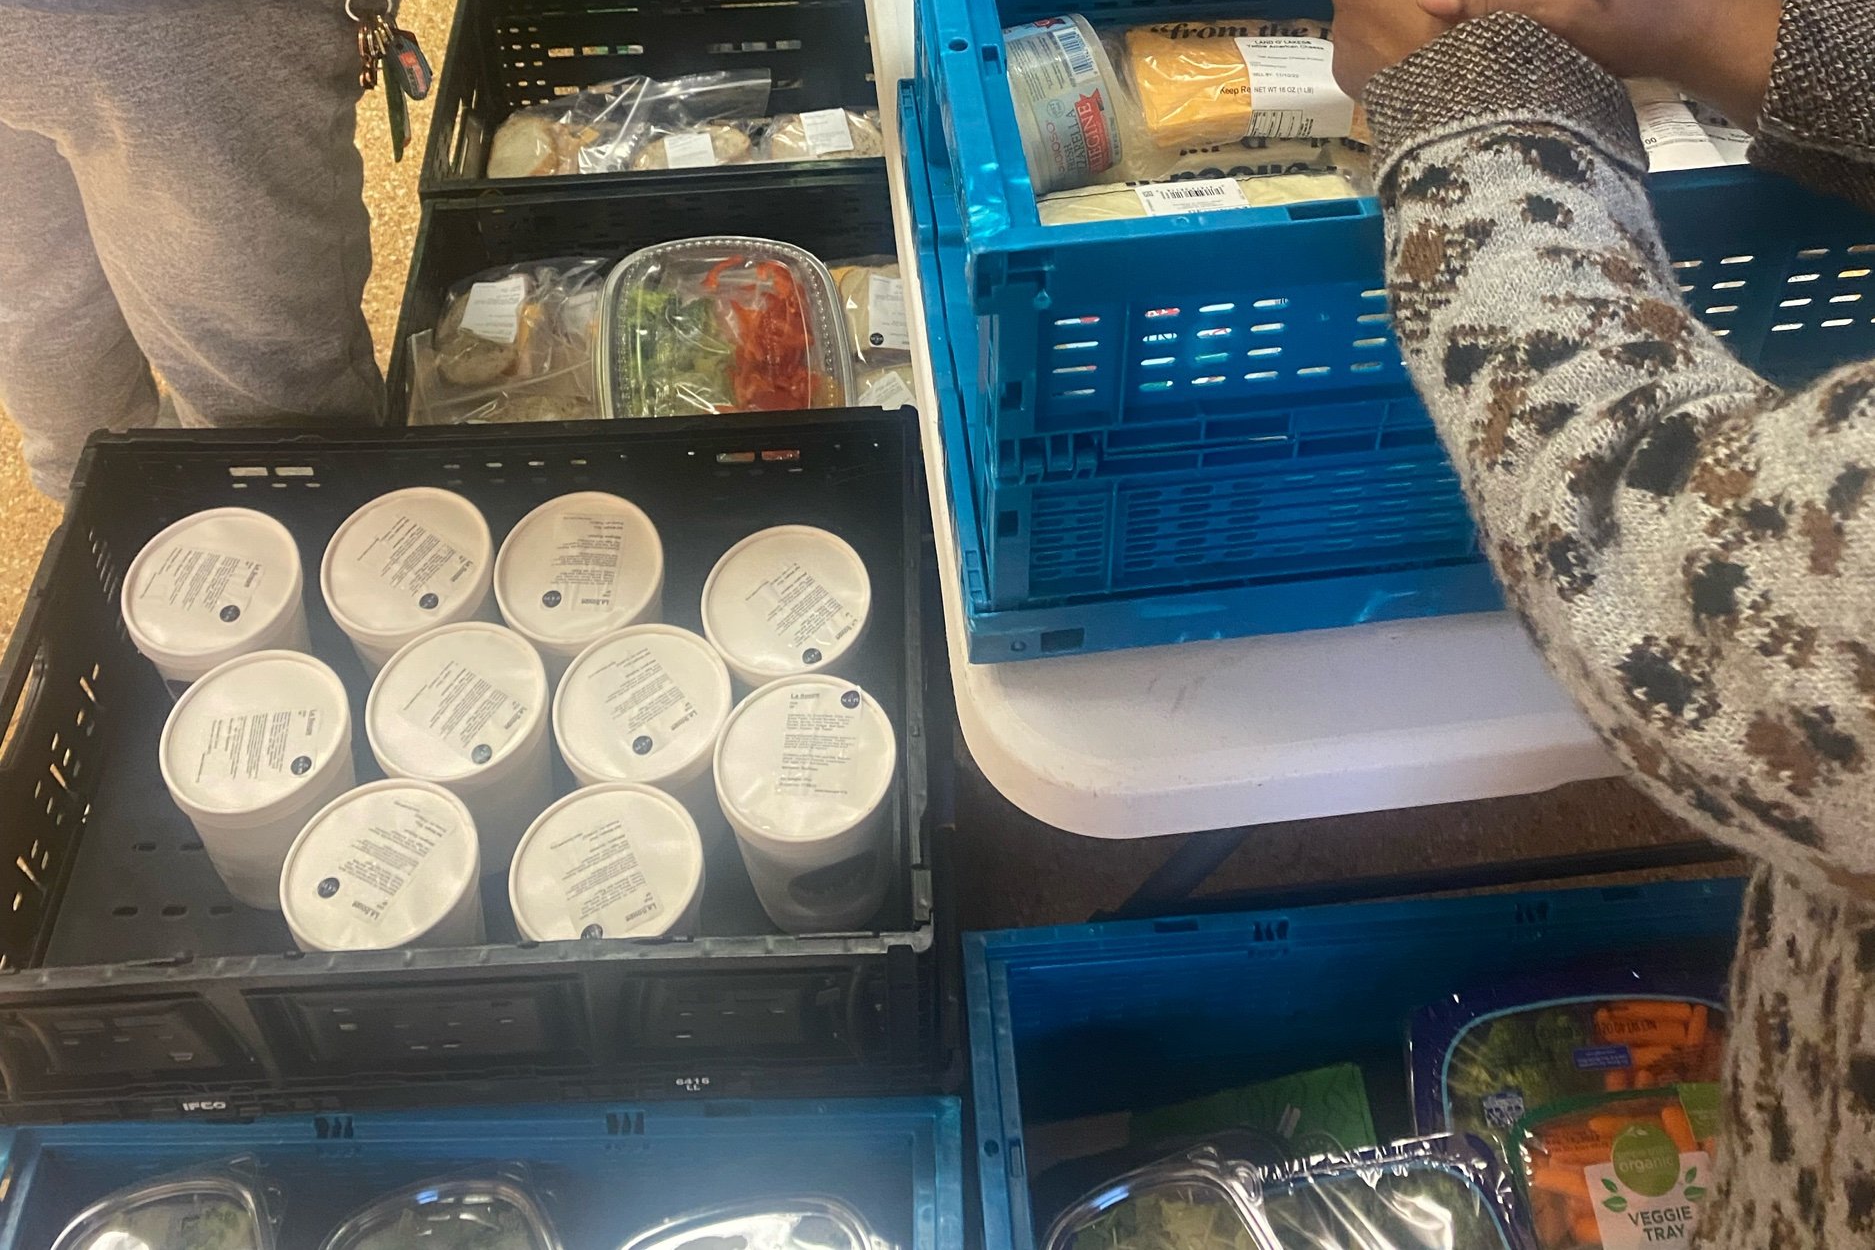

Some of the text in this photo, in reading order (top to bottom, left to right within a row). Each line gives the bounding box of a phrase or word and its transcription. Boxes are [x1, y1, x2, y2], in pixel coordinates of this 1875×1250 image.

[1219, 86, 1239, 96] Keep
[182, 1101, 227, 1112] IFCO
[1619, 1156, 1675, 1174] organic
[1627, 1205, 1694, 1227] VEGGIE
[1642, 1224, 1685, 1242] TRAY
